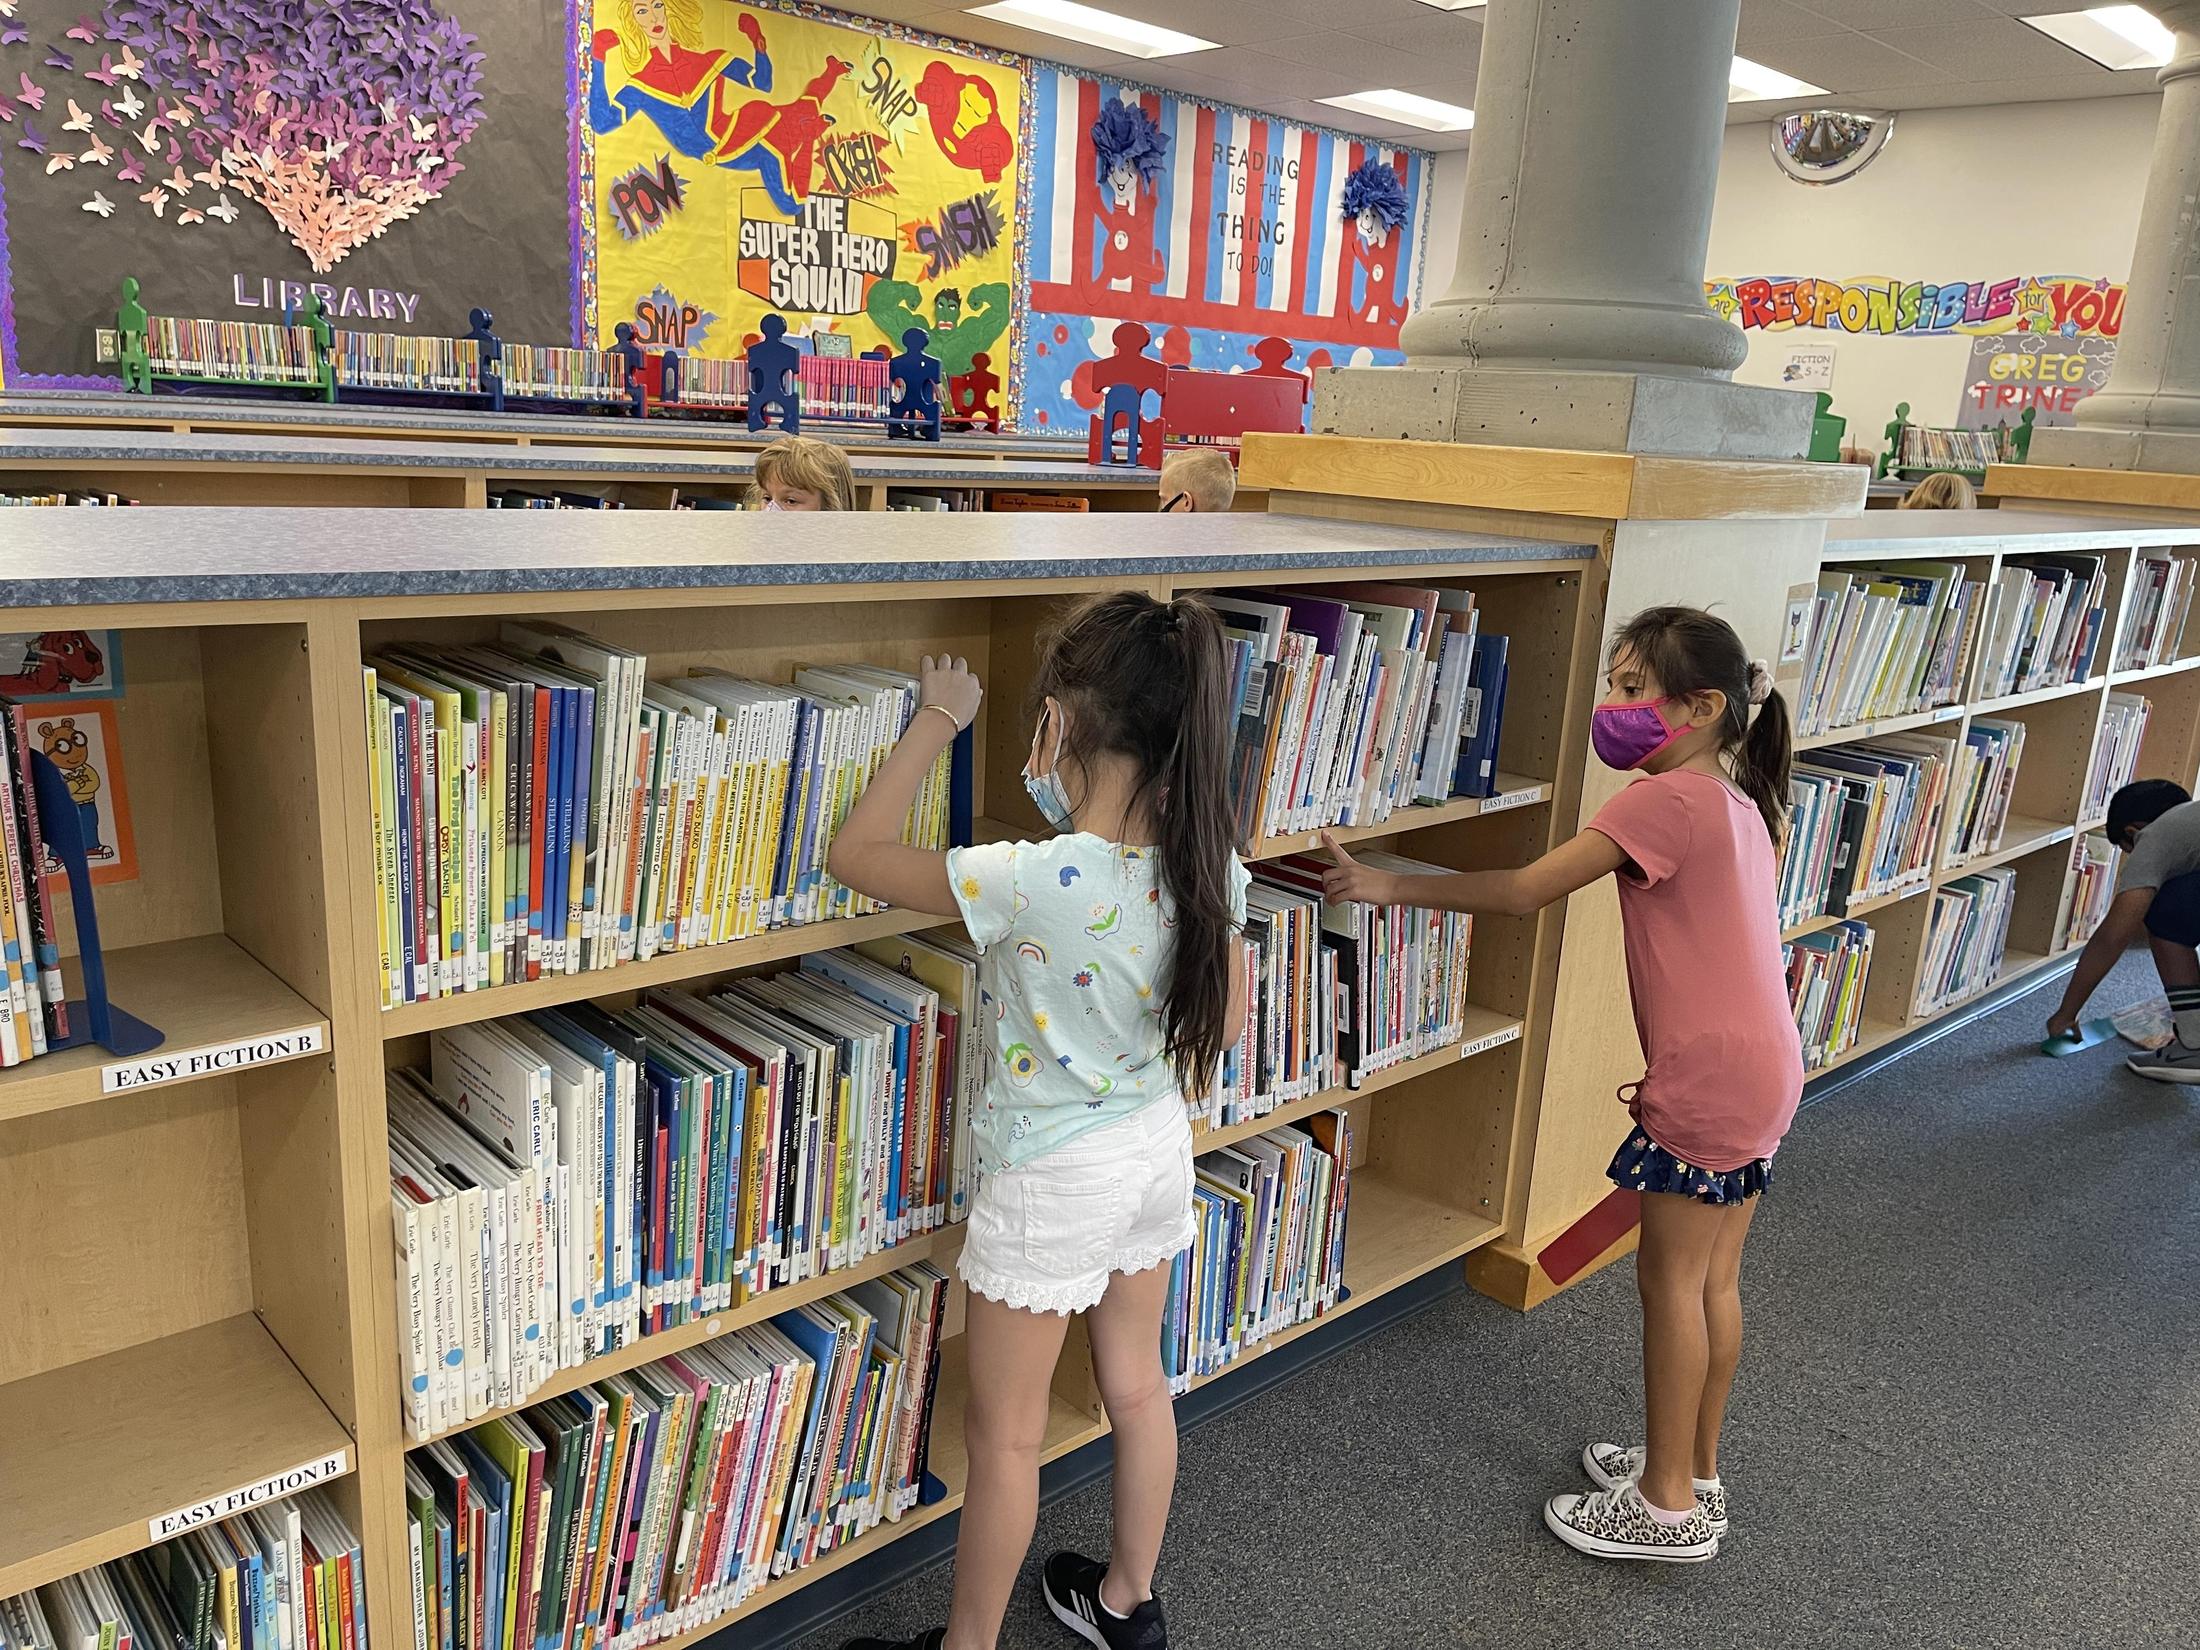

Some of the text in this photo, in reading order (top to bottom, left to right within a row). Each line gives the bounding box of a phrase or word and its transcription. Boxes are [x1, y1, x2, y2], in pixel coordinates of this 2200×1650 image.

[861, 57, 917, 127] SNAP
[1212, 143, 1299, 180] READING
[612, 162, 684, 236] POW
[1231, 174, 1286, 205] IS THE
[804, 195, 843, 231] THE
[1217, 212, 1285, 245] THING
[740, 221, 888, 274] SUPER HERO
[916, 200, 997, 276] SMASH
[1227, 251, 1272, 278] TO DO!
[234, 273, 420, 323] LIBRARY
[770, 257, 863, 314] SQUAD
[1714, 277, 2124, 336] are RESPONSIBLE for YOU
[636, 303, 697, 348] SNAP
[1791, 355, 1830, 364] FICTION
[1805, 367, 1812, 376] S
[1820, 367, 1829, 376] Z
[1989, 353, 2088, 382] GREG
[425, 712, 435, 775] HIGH-WIRE HENRY
[497, 716, 505, 739] Verdi
[539, 720, 547, 766] STELLALUNA
[563, 702, 577, 854] Cannon STELLALUNA
[732, 767, 740, 790] BISCUIT
[743, 766, 751, 792] BISCUIT
[758, 763, 767, 795] BATHTIME
[509, 763, 518, 830] CRICKWING
[729, 791, 737, 810] MEETS
[1484, 797, 1501, 809] EASY
[1503, 792, 1531, 805] FICTION
[451, 776, 460, 884] The Frog Principal
[547, 798, 556, 854] STELLALUNA
[656, 813, 666, 833] LITTLE
[691, 784, 705, 849] PEDRO'S BURRO
[736, 817, 745, 844] GARDEN
[1, 782, 24, 903] ARTHUR'S PERFECT CHRISTMAS
[385, 828, 393, 842] The
[653, 835, 663, 862] SPOTTED
[724, 825, 732, 843] CLASS
[377, 871, 383, 885] ox
[388, 873, 396, 904] Sneezes
[441, 860, 450, 898] TEACHER!
[1464, 1042, 1482, 1055] EASY
[1483, 1032, 1511, 1049] FICTION
[115, 1036, 312, 1088] EASY FICTION B
[532, 1100, 541, 1156] ERIC CARLE
[712, 1140, 720, 1164] Where
[637, 1163, 643, 1177] Me
[711, 1166, 719, 1176] Is
[635, 1184, 643, 1202] Star
[497, 1196, 505, 1227] Eric Carle
[443, 1215, 453, 1250] Eric Carle
[537, 1256, 543, 1269] TO
[498, 1241, 509, 1321] The Very Busy Spider
[511, 1241, 524, 1346] The Very Hungry Caterpilla
[526, 1241, 536, 1320] The Very Quiet Cricket
[410, 1272, 423, 1355] The Very Busy Spider
[432, 1261, 445, 1371] The Very Hungry Caterpillar
[468, 1252, 482, 1350] The Very Lonely Firefly
[835, 1333, 845, 1358] CHOI
[820, 1413, 828, 1431] THE
[814, 1434, 825, 1458] NAME
[160, 1460, 337, 1535] EASY FICTION B
[414, 1545, 420, 1556] MY
[415, 1560, 423, 1625] GRANDMOTHER'S
